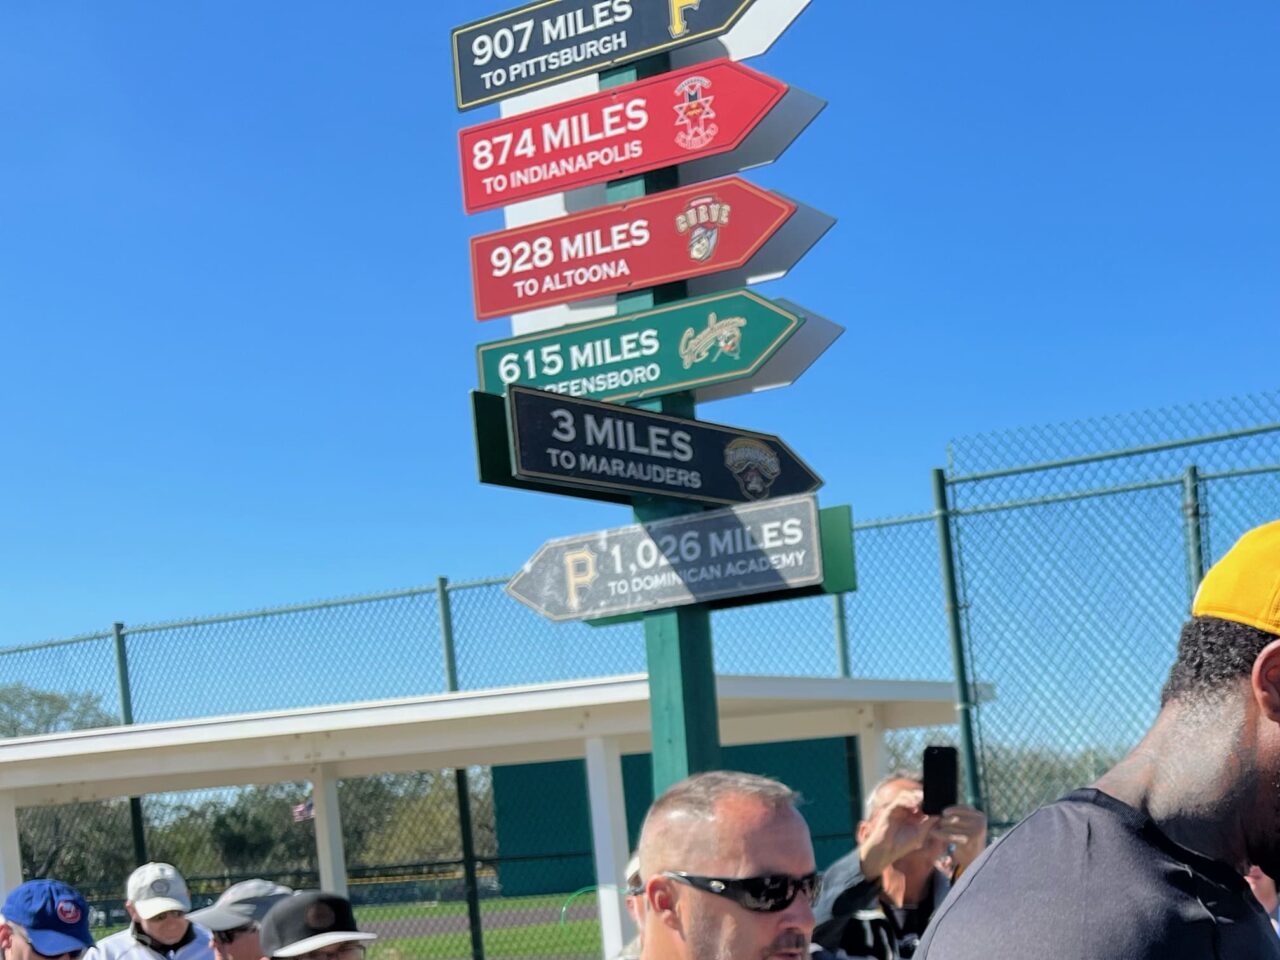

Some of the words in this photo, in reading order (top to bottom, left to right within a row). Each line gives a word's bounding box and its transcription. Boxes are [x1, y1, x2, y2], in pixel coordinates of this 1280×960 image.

[472, 19, 534, 66] 907
[542, 0, 632, 45] MILES
[480, 68, 507, 89] TO
[509, 31, 628, 82] PITTSBURGH
[472, 128, 536, 171] 874
[542, 98, 648, 153] MILES
[482, 175, 507, 194] TO
[510, 140, 643, 188] INDIANAPOLIS
[675, 204, 731, 233] CURVE
[490, 236, 554, 277] 928
[560, 219, 650, 262] MILES
[513, 278, 539, 298] TO
[542, 259, 631, 293] ALTOONA
[498, 344, 564, 384] 615
[569, 329, 660, 371] MILES
[544, 363, 661, 397] EENSBORO
[550, 409, 577, 442] 3
[584, 413, 694, 462] MILES
[546, 447, 576, 470] TO
[579, 453, 702, 489] MARAUDERS
[608, 580, 628, 596] TO
[632, 565, 722, 591] DOMINICAN
[724, 550, 806, 577] ACADEMY
[611, 530, 701, 575] 1,026
[708, 517, 803, 557] MILES
[563, 547, 599, 610] P
